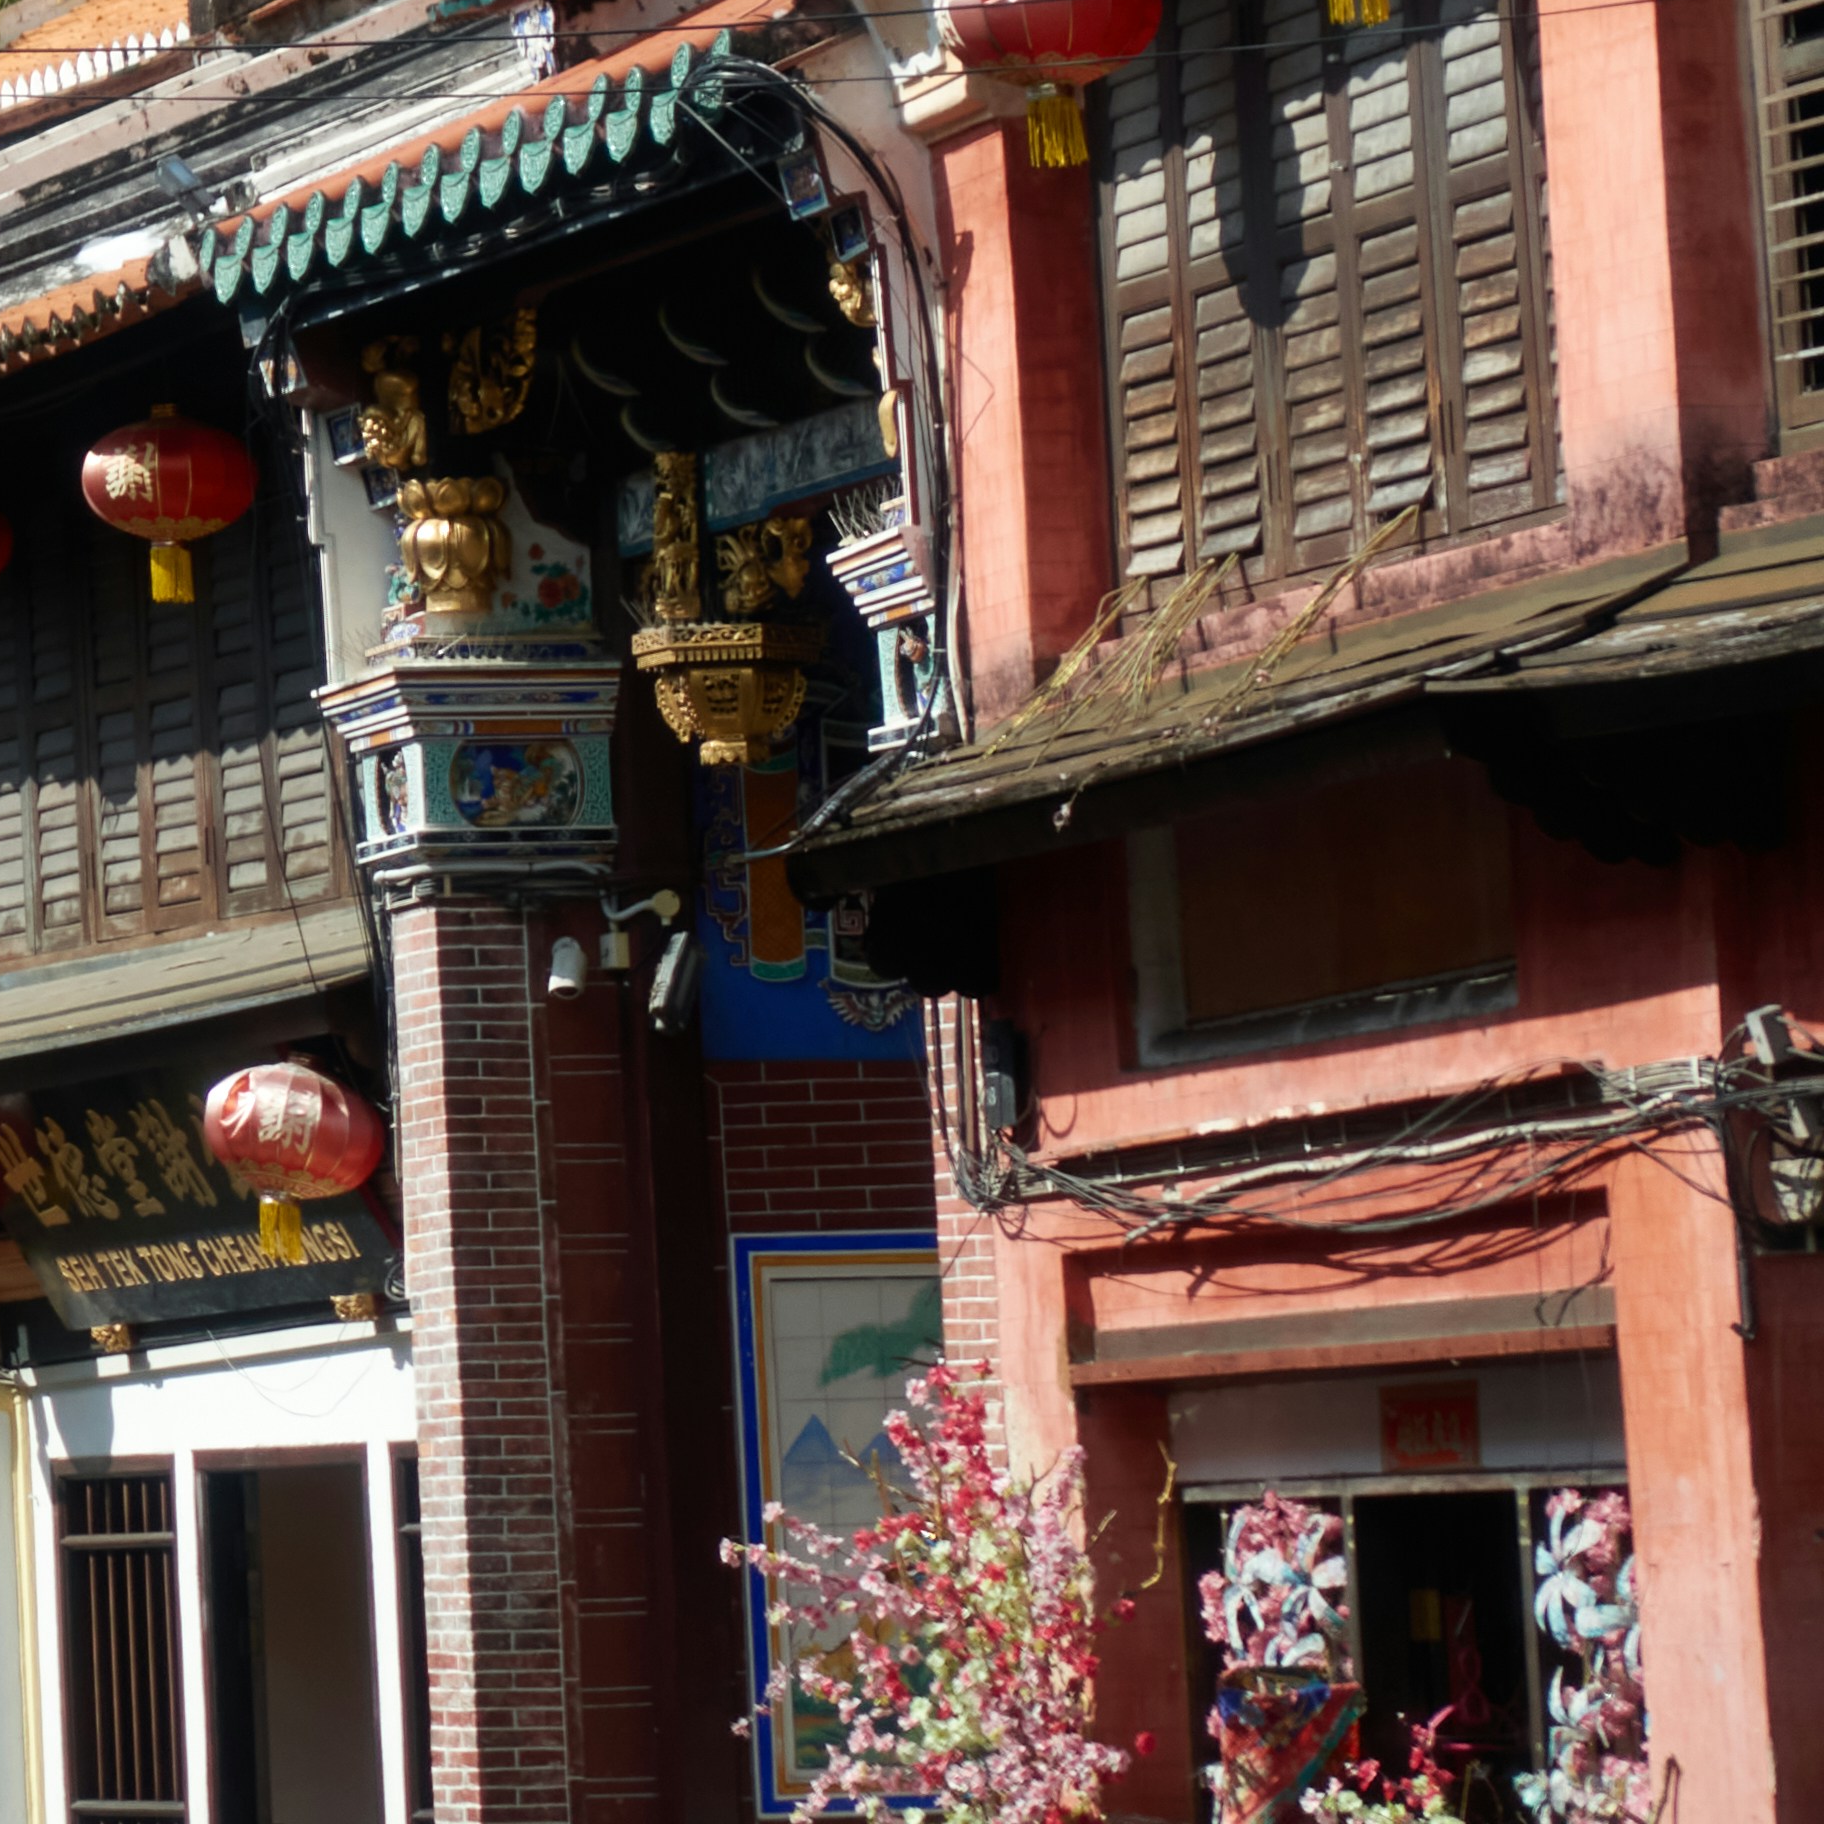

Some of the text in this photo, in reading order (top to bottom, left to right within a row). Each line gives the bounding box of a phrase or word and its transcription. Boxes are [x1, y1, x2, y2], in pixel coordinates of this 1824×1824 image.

[55, 1253, 108, 1293] SEH
[94, 1247, 150, 1289] TEK
[136, 1240, 204, 1283] TONG
[196, 1232, 277, 1277] CHEAH
